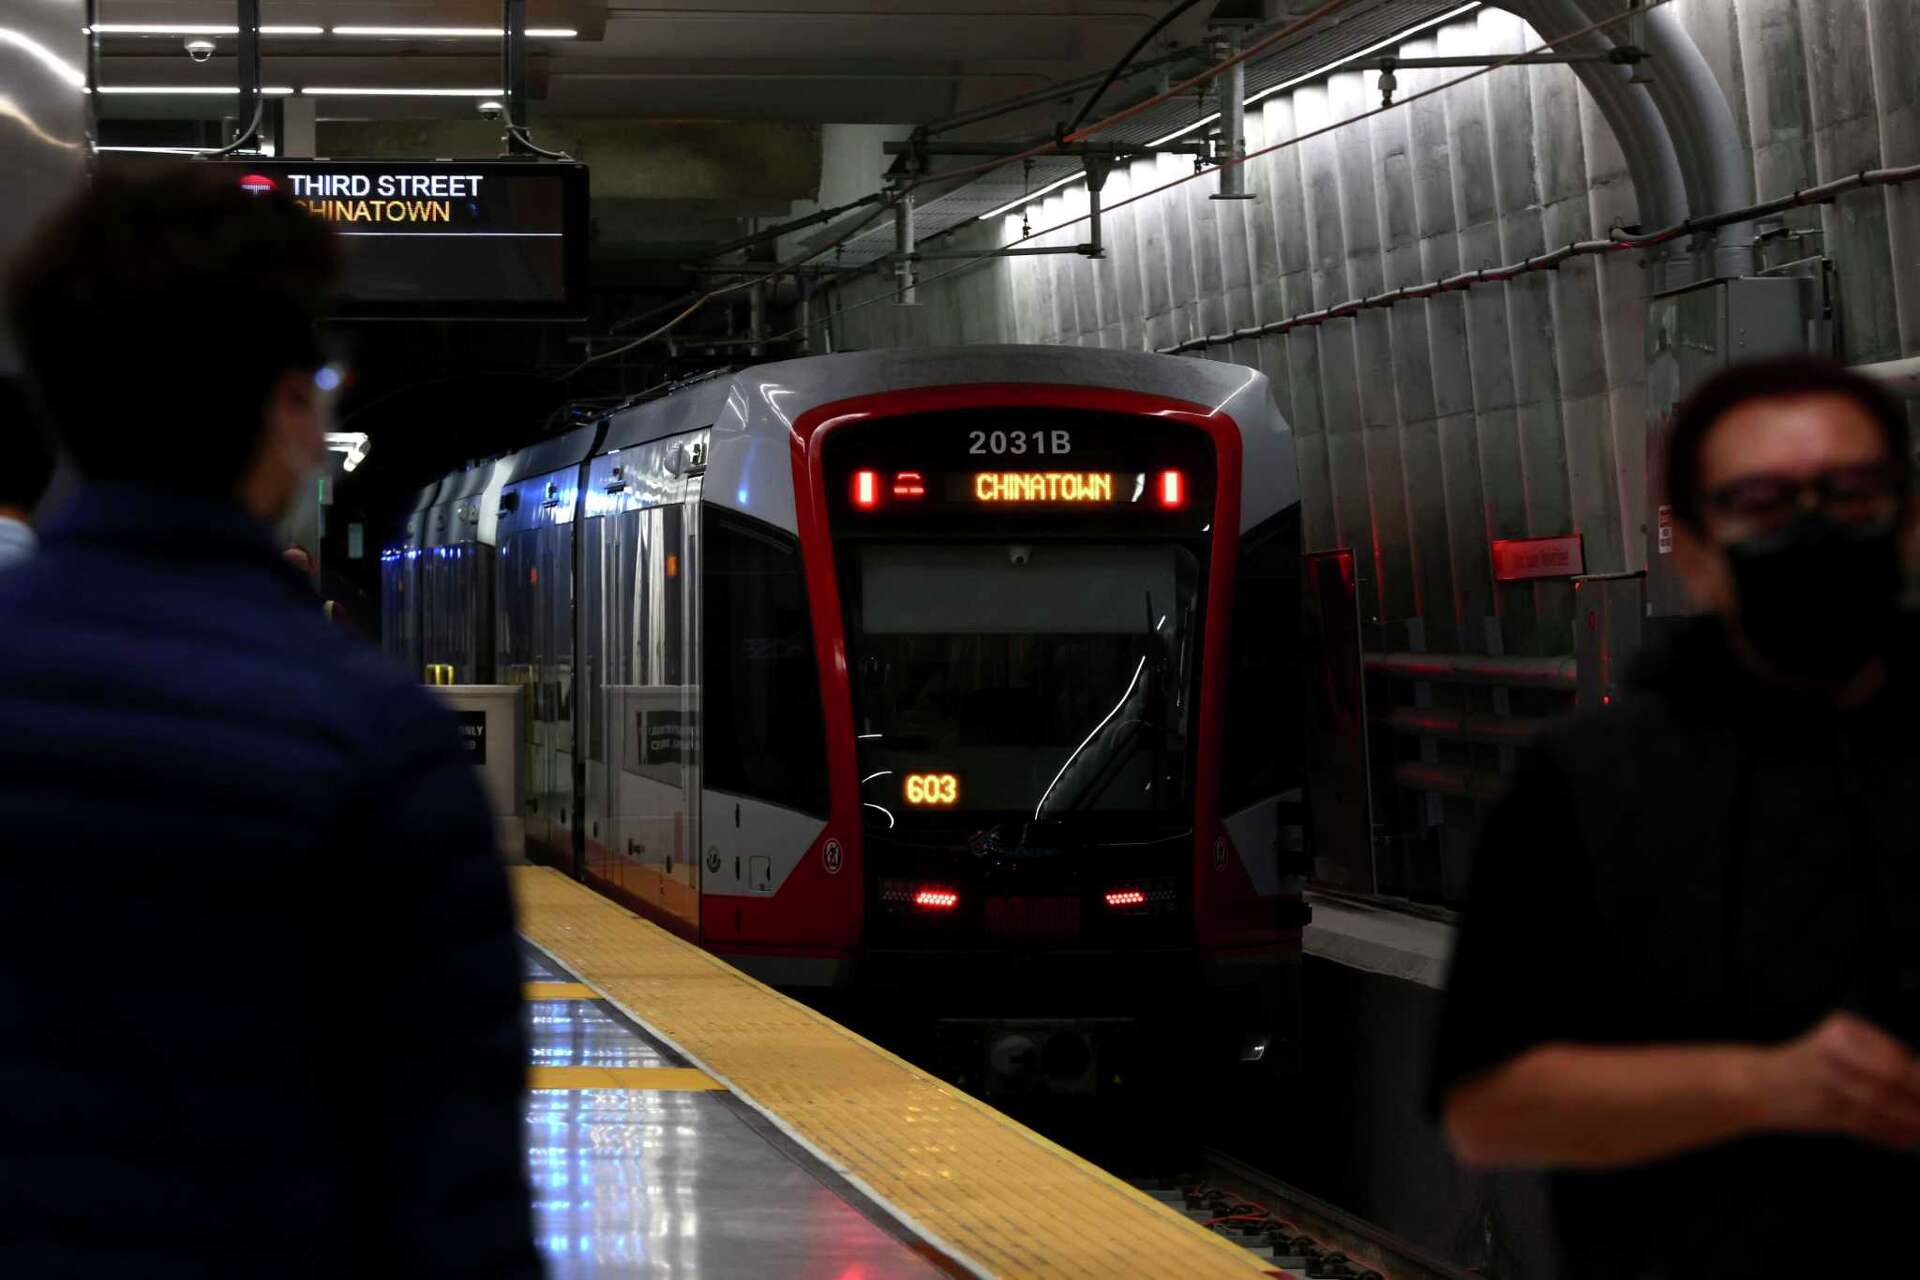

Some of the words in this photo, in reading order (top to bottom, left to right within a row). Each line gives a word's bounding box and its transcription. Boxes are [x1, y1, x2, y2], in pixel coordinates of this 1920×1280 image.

[287, 174, 370, 197] THIRD
[377, 174, 484, 197] STREET
[968, 430, 1072, 455] 2031B
[975, 472, 1112, 501] CHINATOWN
[906, 774, 957, 803] 603
